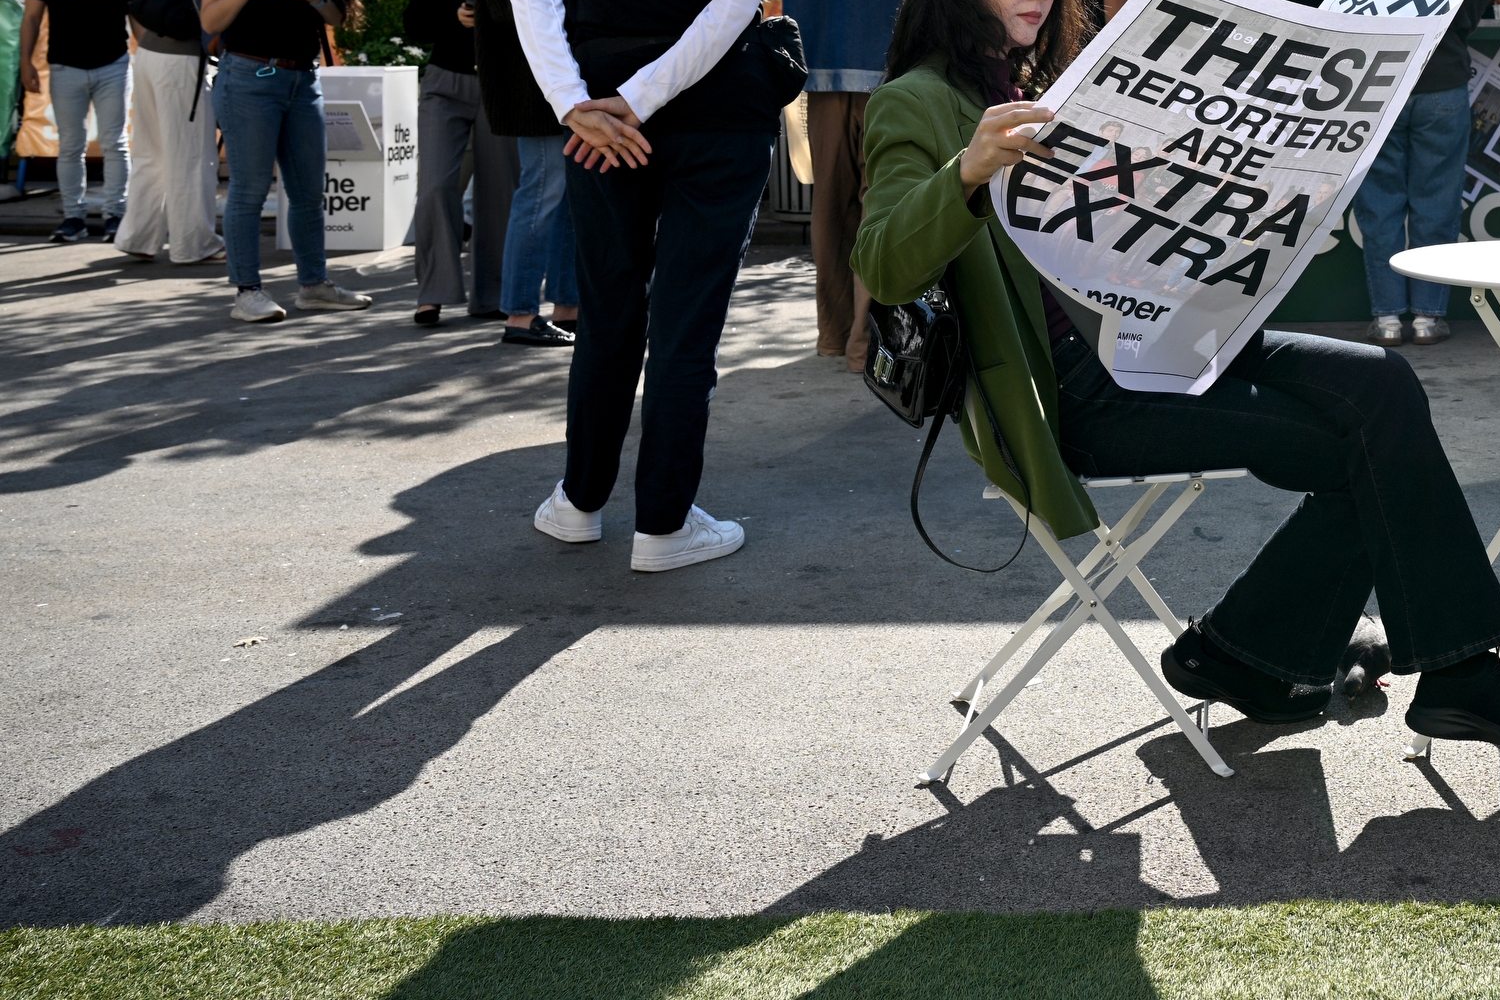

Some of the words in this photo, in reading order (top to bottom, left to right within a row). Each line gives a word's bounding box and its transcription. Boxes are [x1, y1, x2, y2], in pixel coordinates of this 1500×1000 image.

[1141, 0, 1411, 113] THESE
[1092, 55, 1371, 153] REPORTERS
[394, 124, 410, 143] the
[388, 144, 415, 166] paper
[1162, 128, 1275, 181] ARE
[324, 173, 355, 193] he
[1025, 122, 1310, 247] EXTRA
[323, 195, 371, 216] per
[1007, 160, 1271, 296] EXTRA
[1117, 332, 1143, 341] AMING
